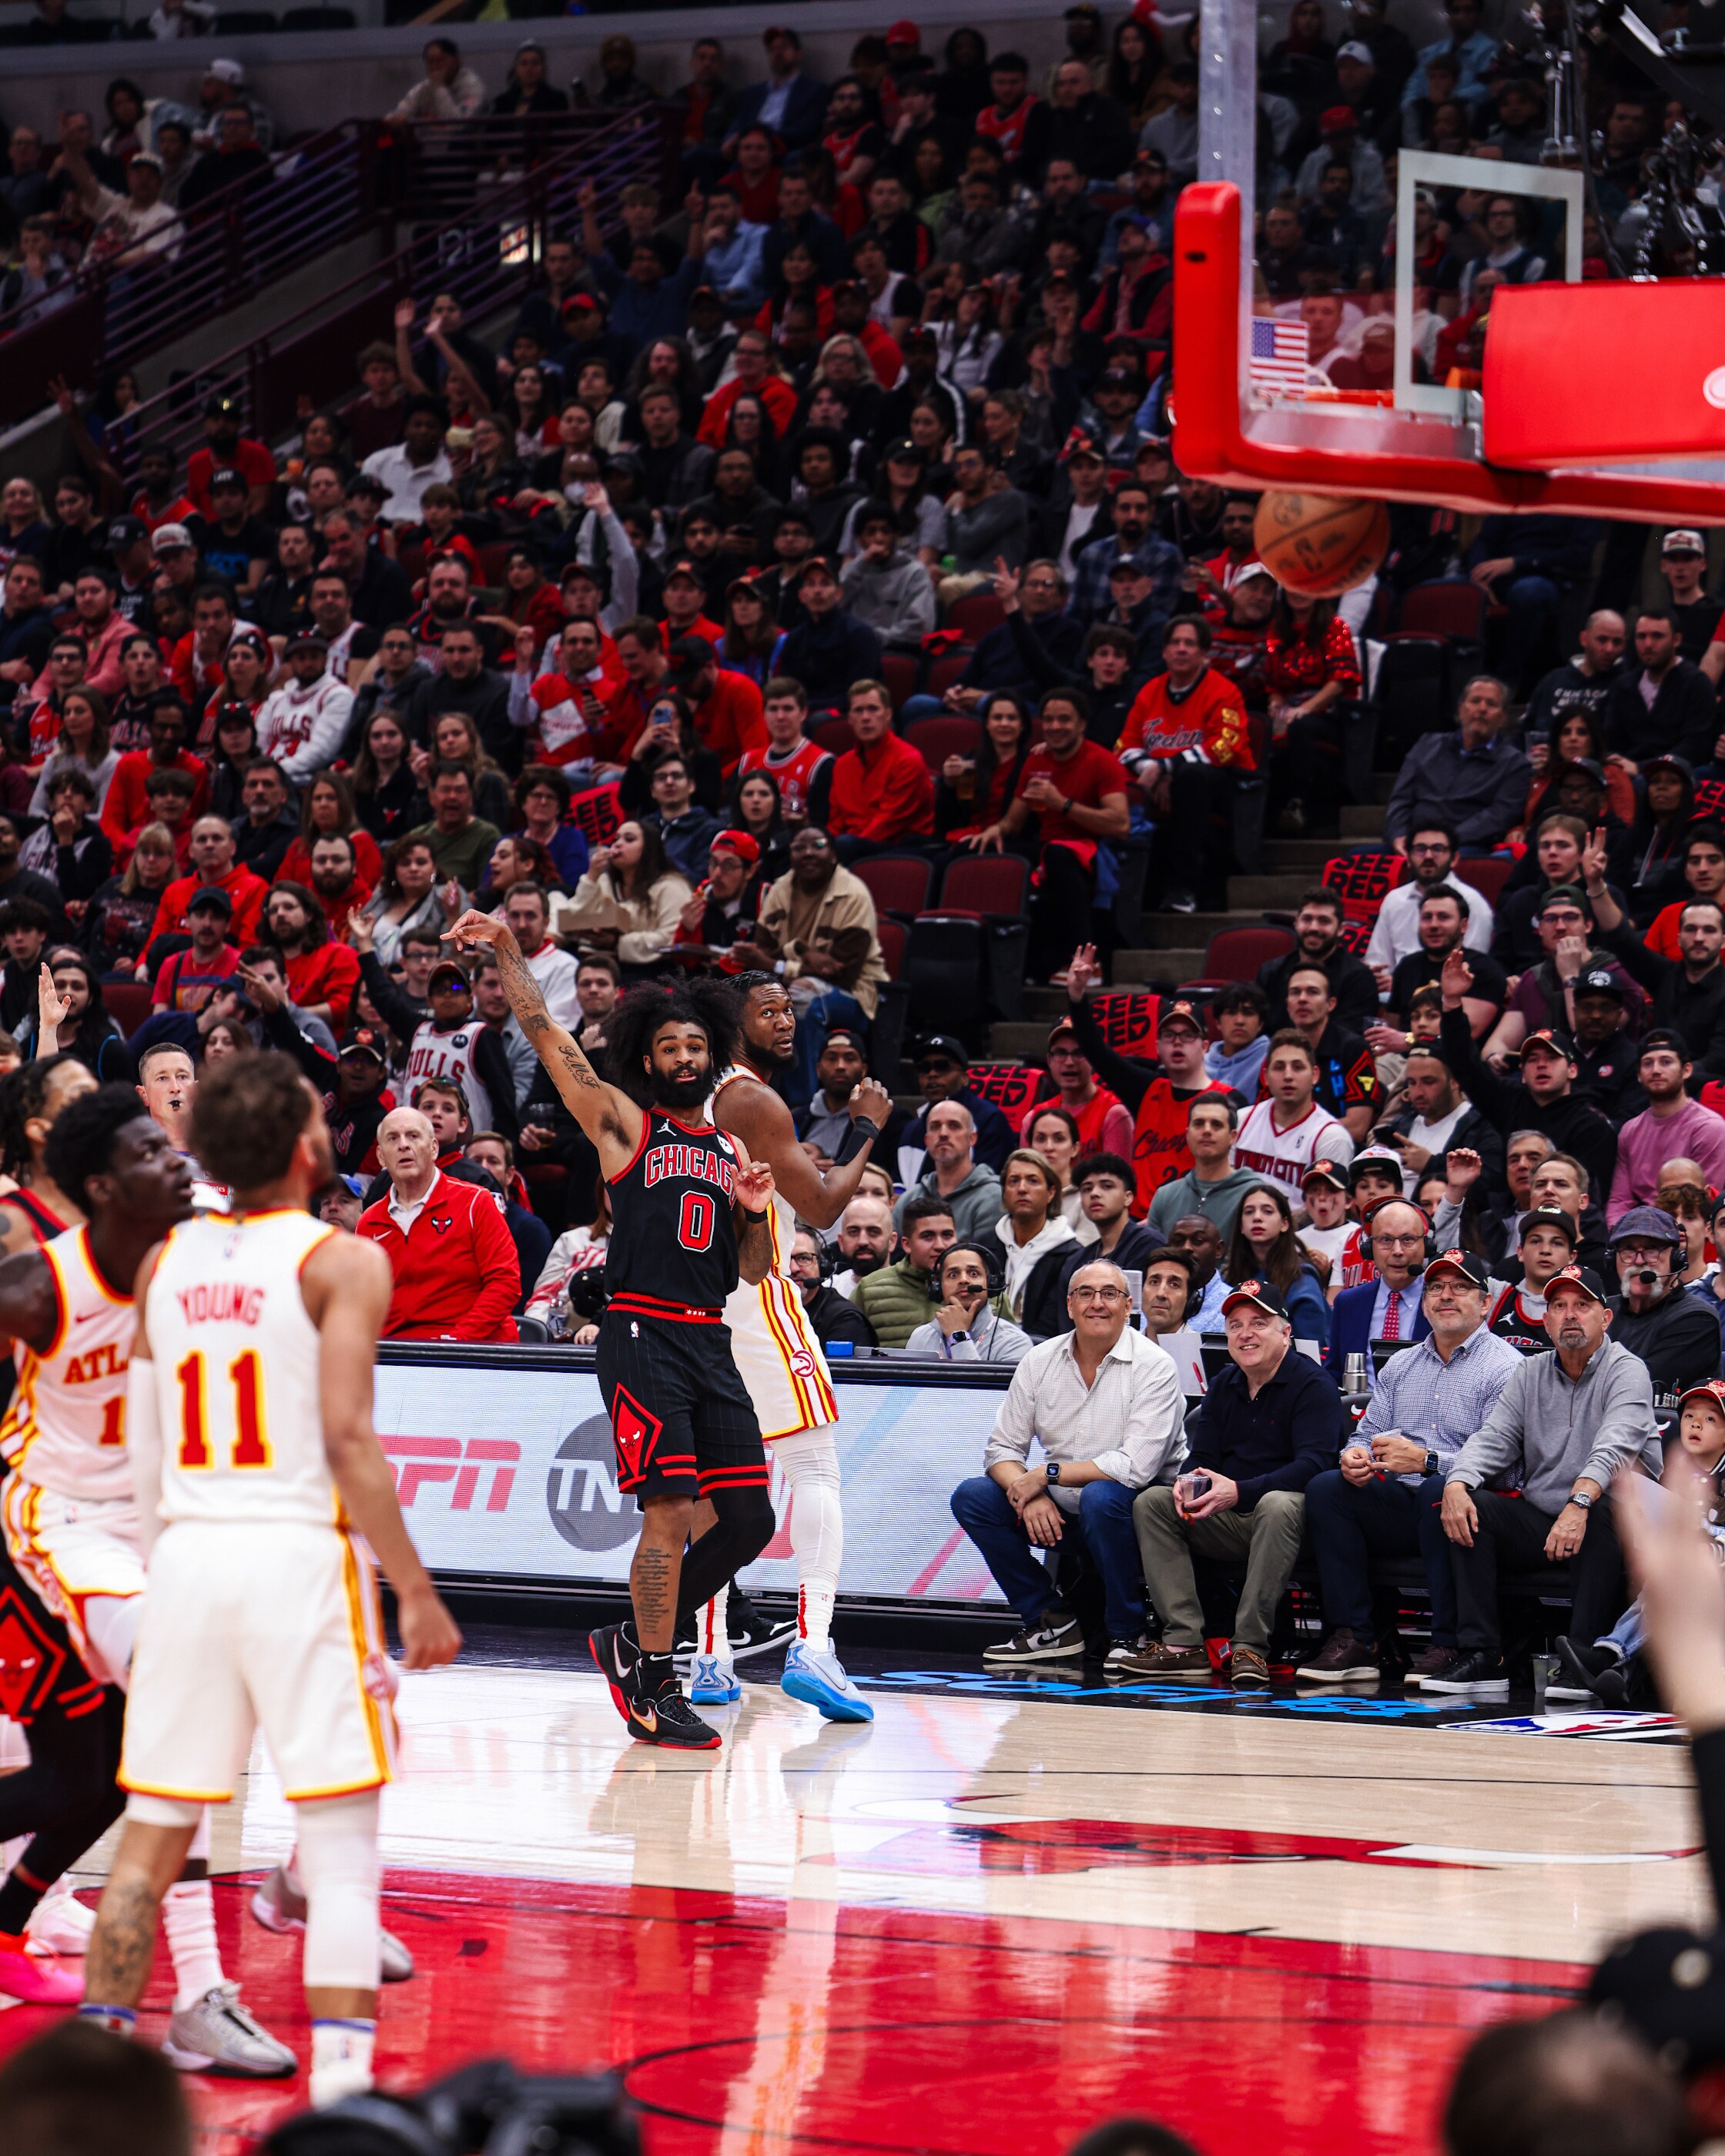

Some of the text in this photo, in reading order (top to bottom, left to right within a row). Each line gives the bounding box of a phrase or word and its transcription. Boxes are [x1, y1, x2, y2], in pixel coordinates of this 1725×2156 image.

[1326, 872, 1390, 900] RED
[1090, 993, 1149, 1021] SEE
[645, 1144, 738, 1210] CHICAG
[678, 1190, 715, 1253] 0
[177, 1283, 266, 1326] YOUNG
[63, 1342, 129, 1384] ATL
[176, 1349, 273, 1469] 11
[376, 1435, 521, 1512] PN
[552, 1458, 645, 1514] TN
